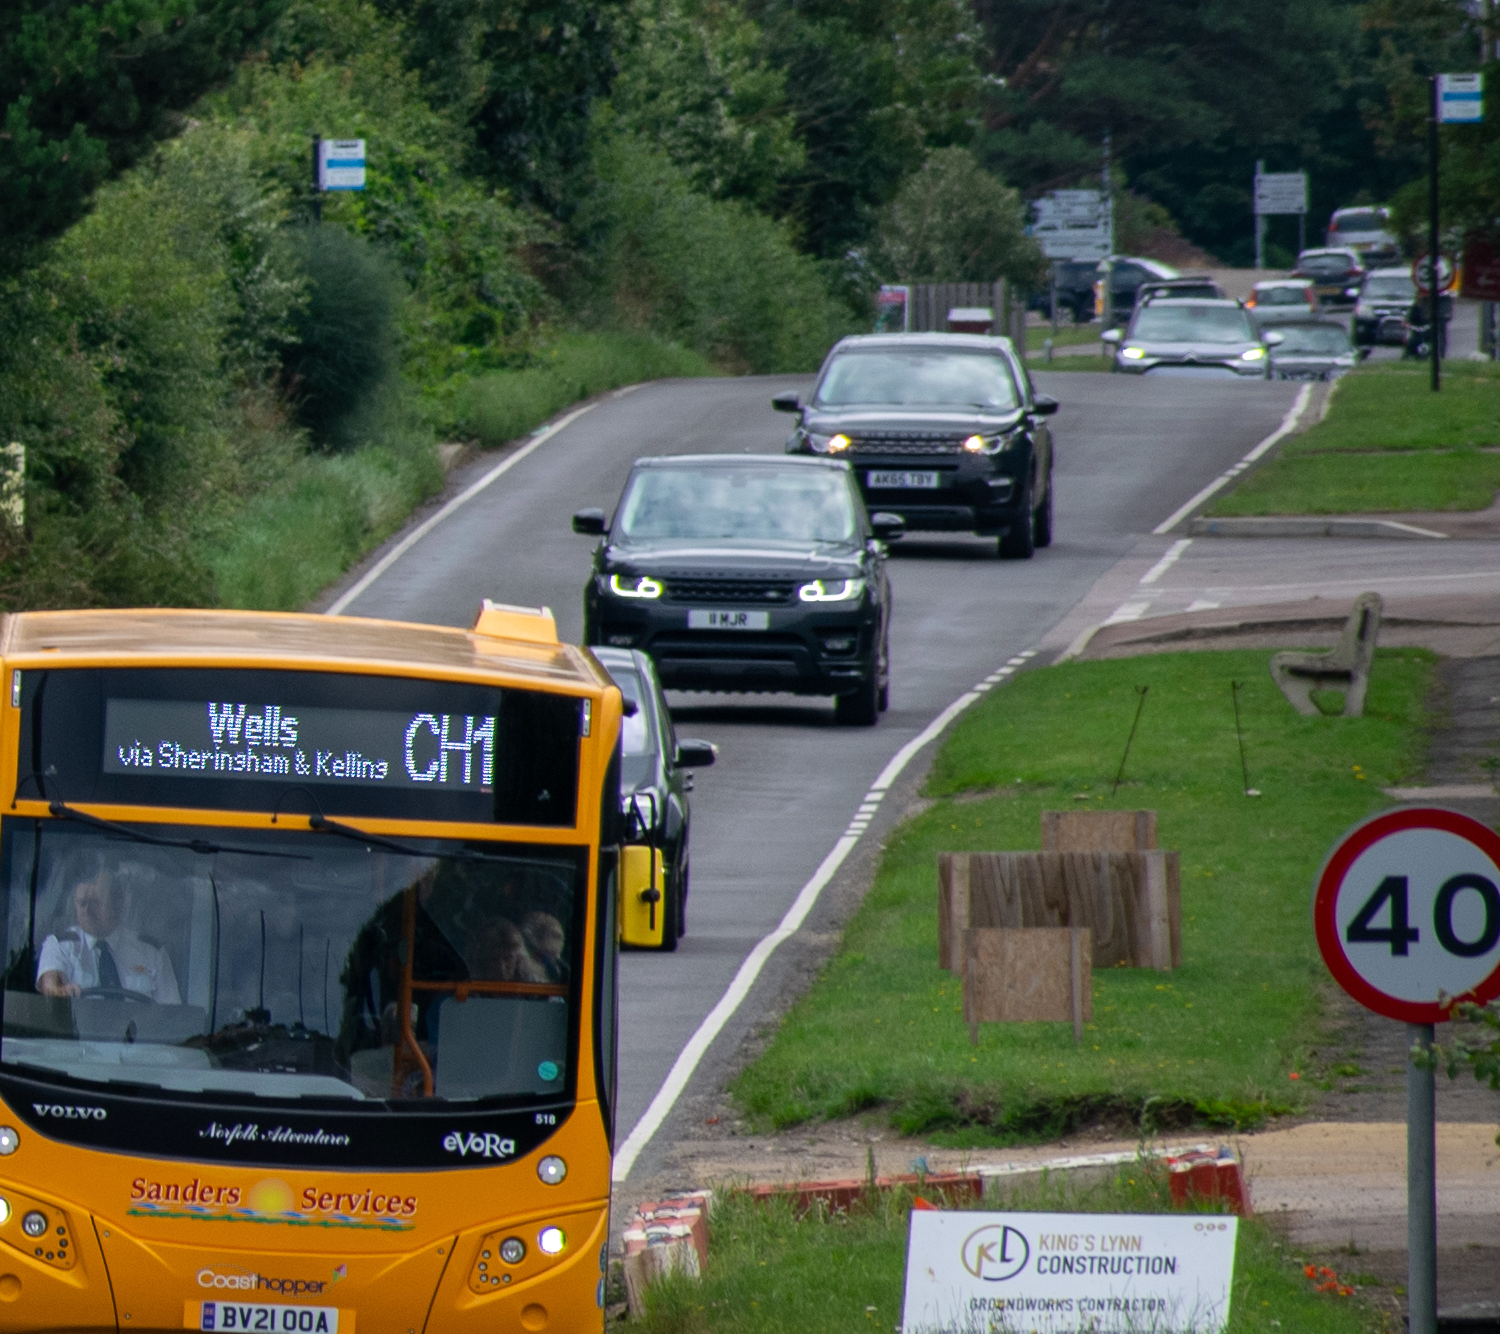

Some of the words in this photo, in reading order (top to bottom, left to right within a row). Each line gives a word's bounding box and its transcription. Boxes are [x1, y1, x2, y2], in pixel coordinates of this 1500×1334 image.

[719, 613, 748, 626] MJR
[208, 701, 298, 747] Wells
[404, 713, 496, 785] CH1
[118, 739, 152, 767] via
[158, 741, 289, 774] Sheringham
[294, 748, 310, 776] &
[315, 749, 389, 780] Kelling
[1346, 873, 1500, 958] 40
[33, 1103, 107, 1120] VOLVO
[535, 1113, 556, 1125] 518
[199, 1121, 257, 1146] Norfolk
[261, 1125, 350, 1146] Adventurer
[130, 1177, 241, 1206] Sanders
[301, 1186, 417, 1216] Services
[1038, 1233, 1096, 1252] KING'S
[1100, 1234, 1143, 1253] LYNN
[1036, 1255, 1177, 1275] CONSTRUCTION
[197, 1269, 328, 1296] Coasthopper
[1078, 1297, 1167, 1313] CONTRACTOR
[222, 1306, 276, 1331] BV21
